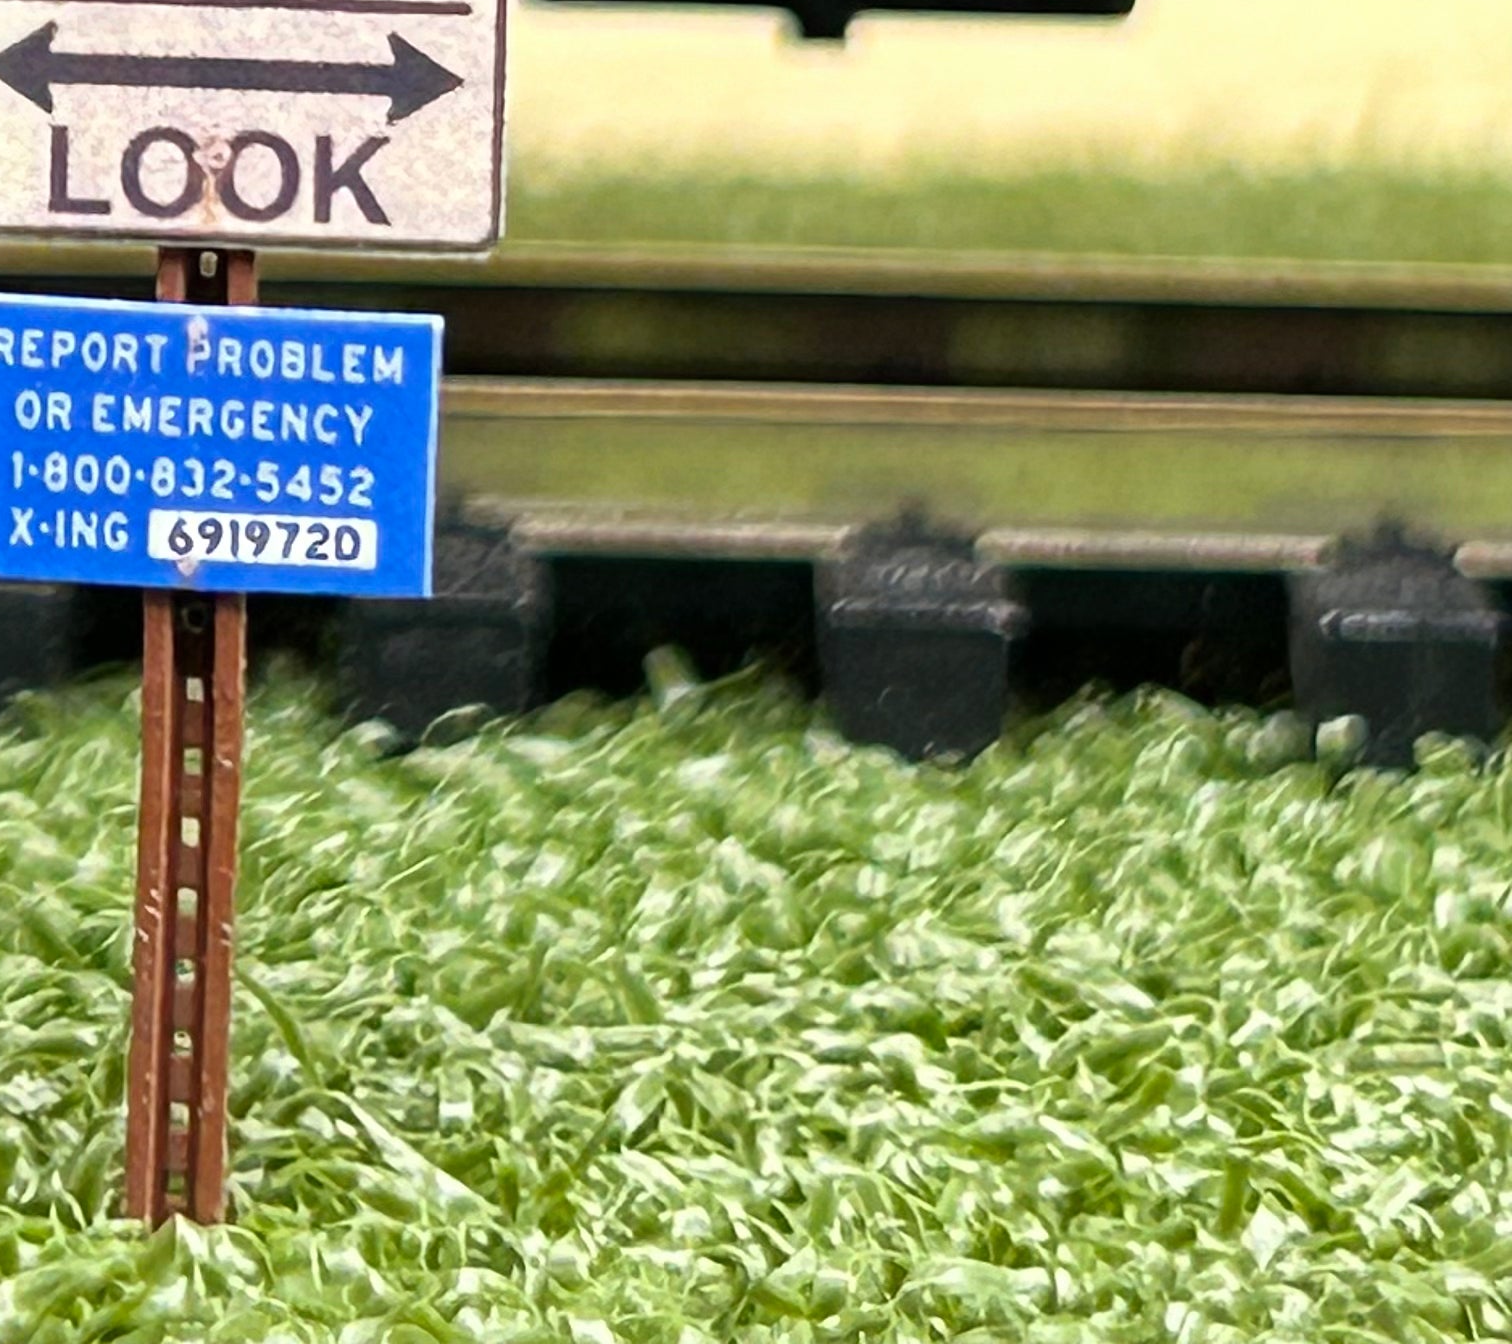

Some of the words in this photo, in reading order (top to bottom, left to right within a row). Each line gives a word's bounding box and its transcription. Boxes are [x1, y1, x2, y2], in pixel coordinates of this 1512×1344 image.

[47, 124, 392, 227] LOOK
[187, 335, 405, 385] PROBLEM
[14, 388, 73, 432] OR
[91, 392, 374, 447] EMERGENCY
